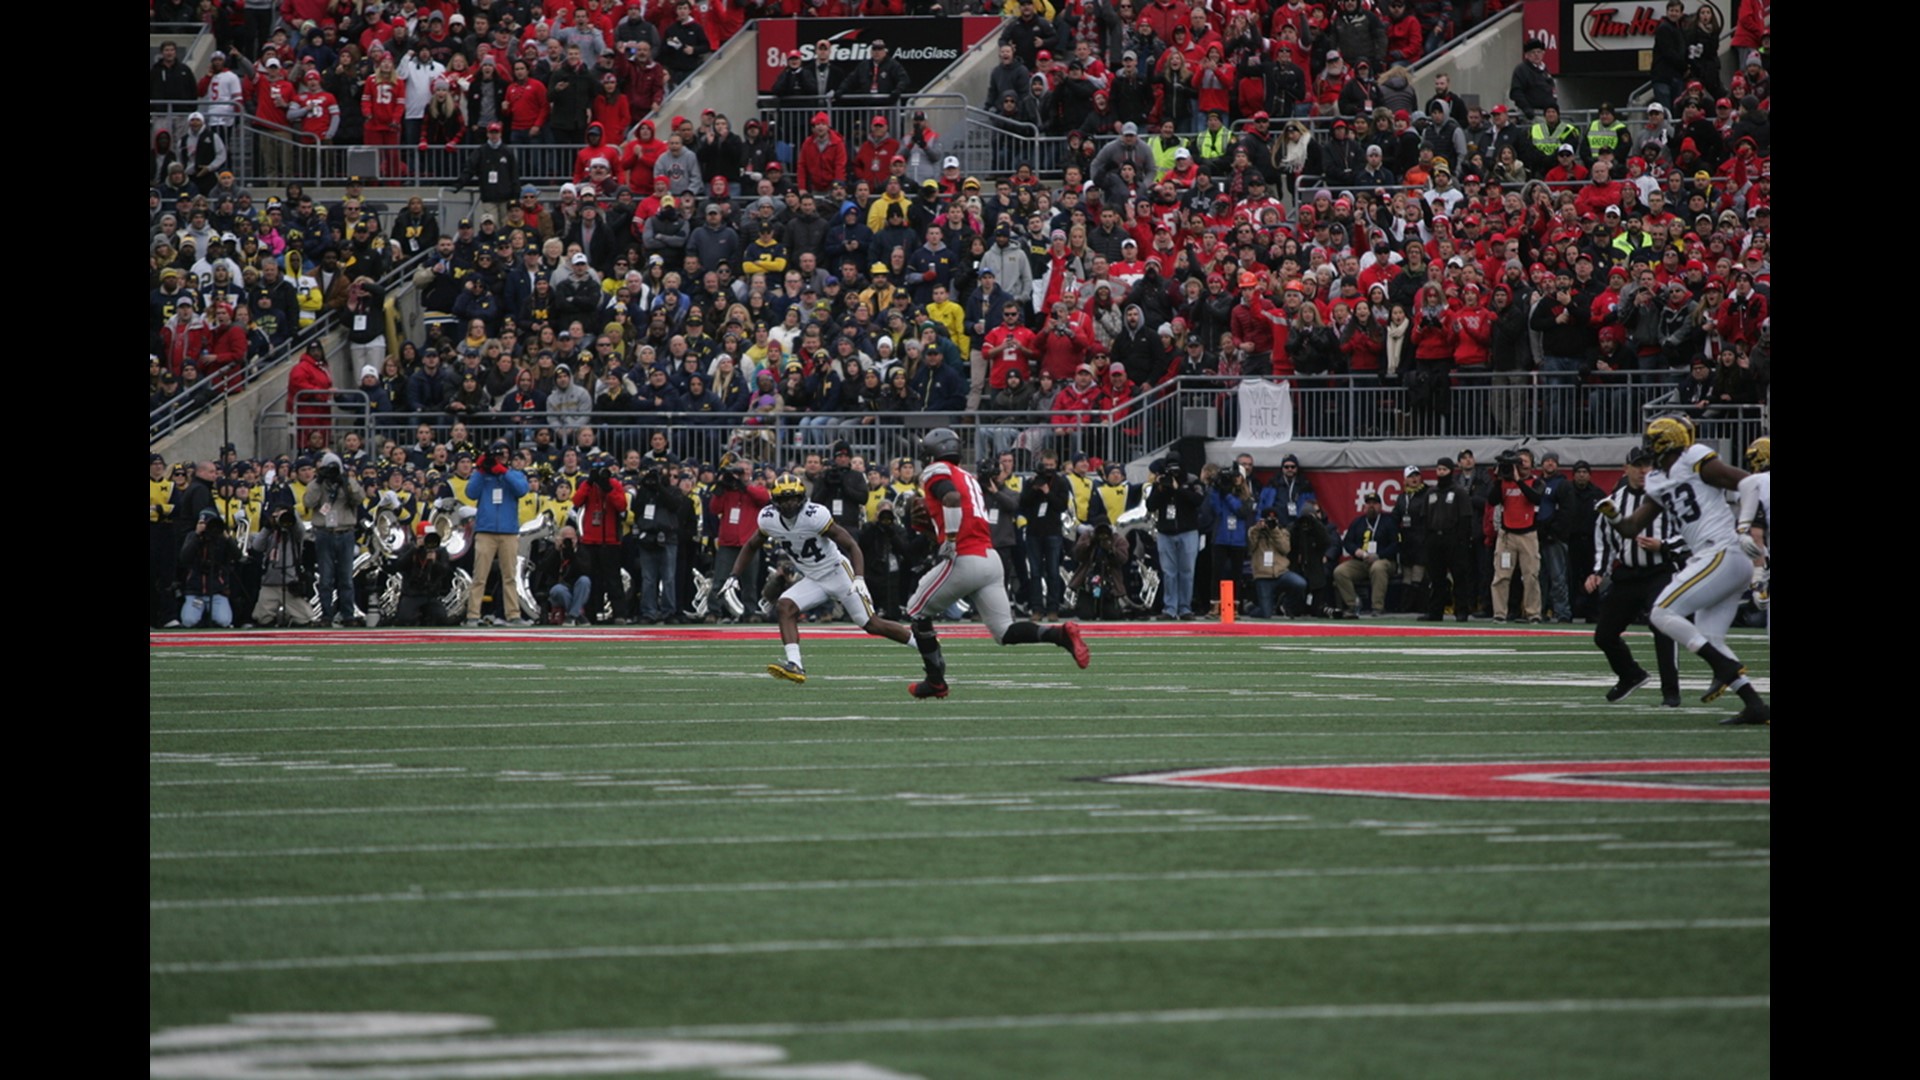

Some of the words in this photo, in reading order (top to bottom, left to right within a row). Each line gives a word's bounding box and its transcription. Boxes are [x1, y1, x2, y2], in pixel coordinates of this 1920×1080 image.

[1589, 8, 1630, 38] Tim
[767, 47, 788, 67] 8A
[892, 46, 958, 60] AutoGlass
[1249, 407, 1278, 427] HATE
